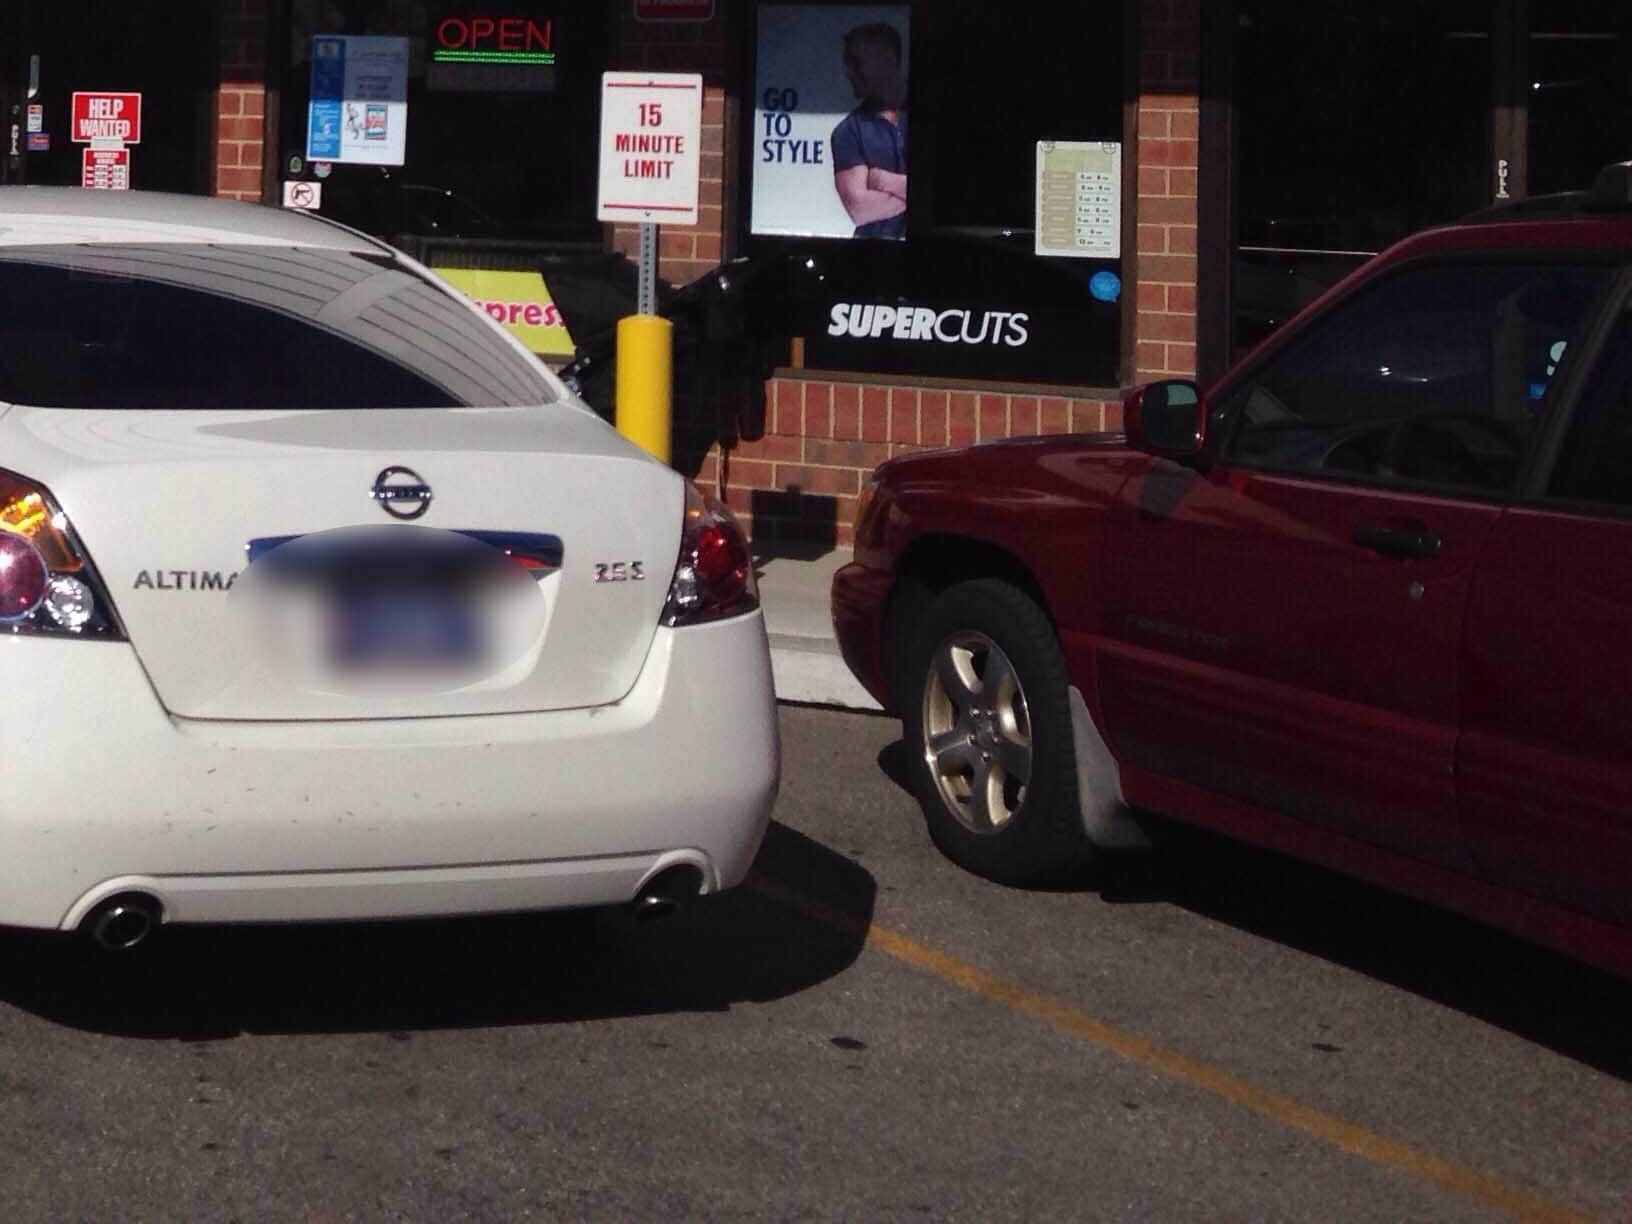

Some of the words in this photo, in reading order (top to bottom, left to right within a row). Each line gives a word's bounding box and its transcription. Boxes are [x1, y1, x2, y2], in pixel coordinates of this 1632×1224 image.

[437, 18, 552, 50] OPEN
[89, 98, 124, 119] HELP
[763, 87, 799, 111] GO
[639, 103, 662, 127] 15
[763, 113, 792, 137] TO
[79, 119, 131, 137] WANTED
[616, 135, 684, 153] MINUTE
[763, 139, 824, 164] STYLE
[624, 159, 674, 179] LIMIT
[465, 294, 566, 328] pres
[827, 303, 1029, 347] SUPERCUTS
